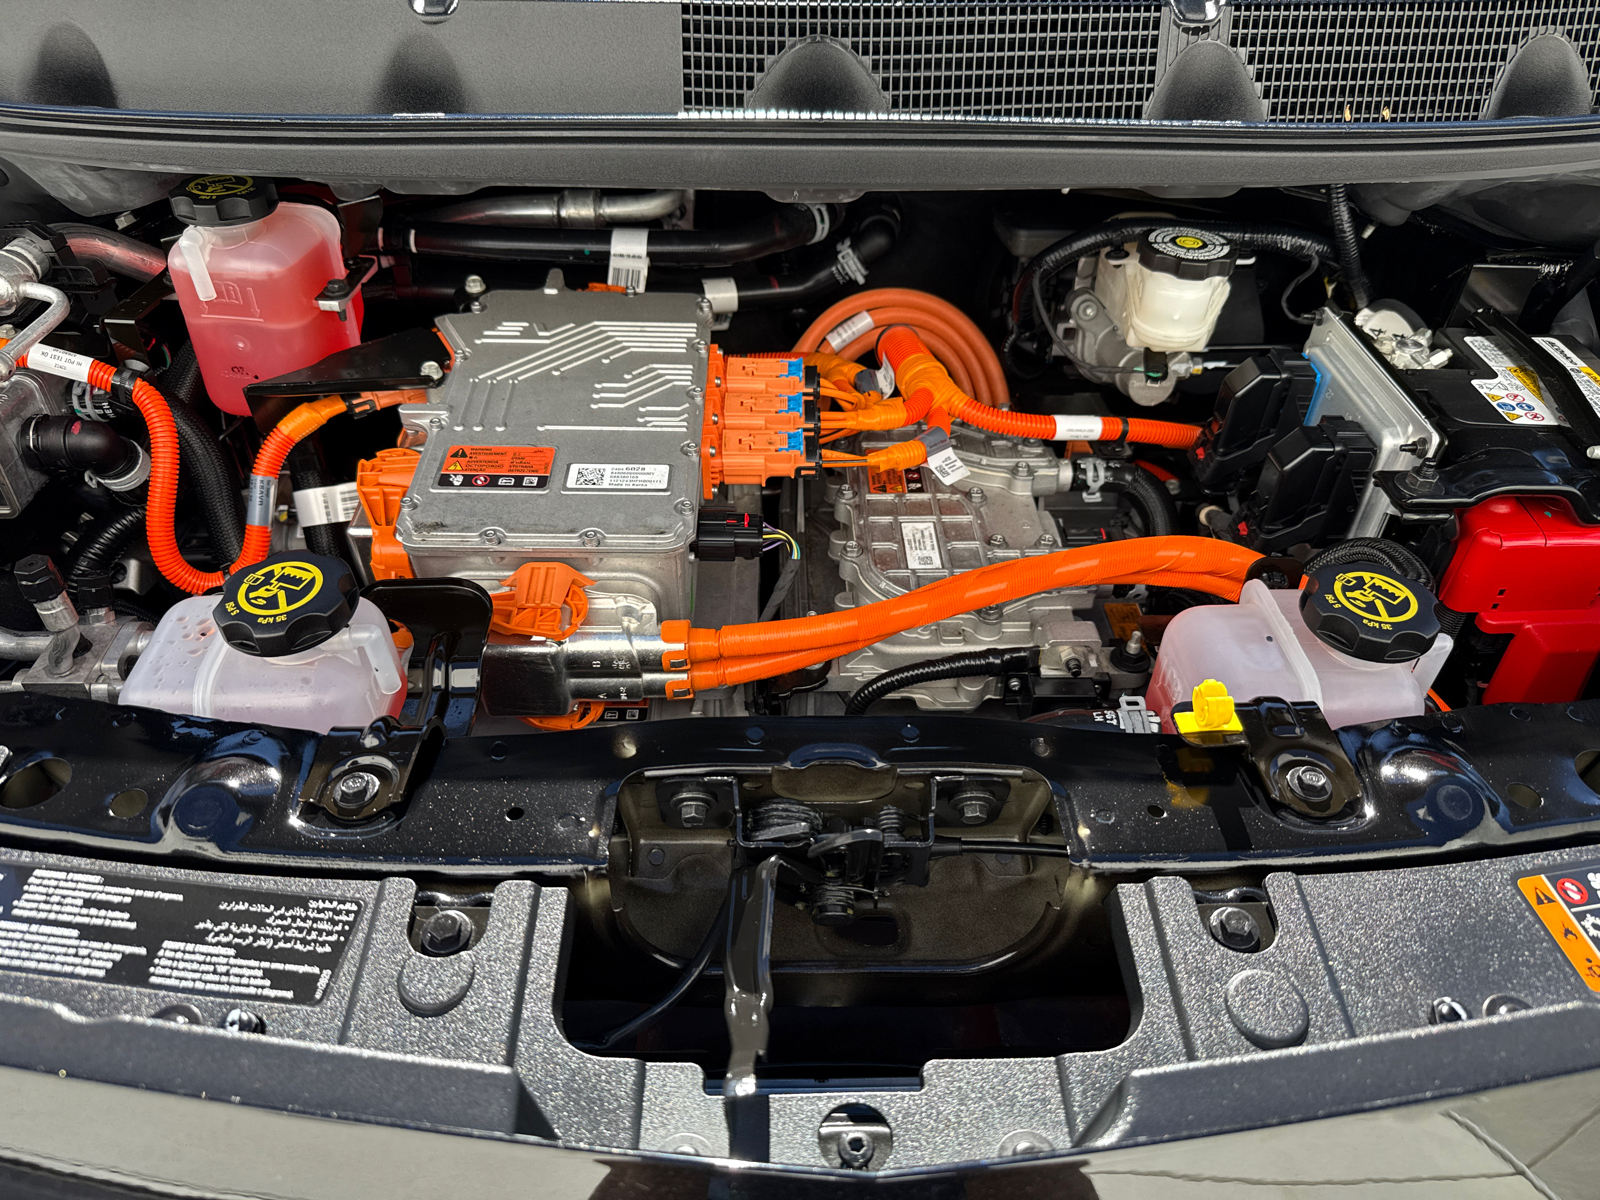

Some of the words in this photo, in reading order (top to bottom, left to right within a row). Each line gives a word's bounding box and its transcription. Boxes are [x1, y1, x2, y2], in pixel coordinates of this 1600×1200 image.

[49, 353, 63, 362] TEST
[64, 357, 75, 366] POT
[256, 616, 274, 624] kPa
[275, 613, 287, 622] 35
[1362, 618, 1379, 628] kPa
